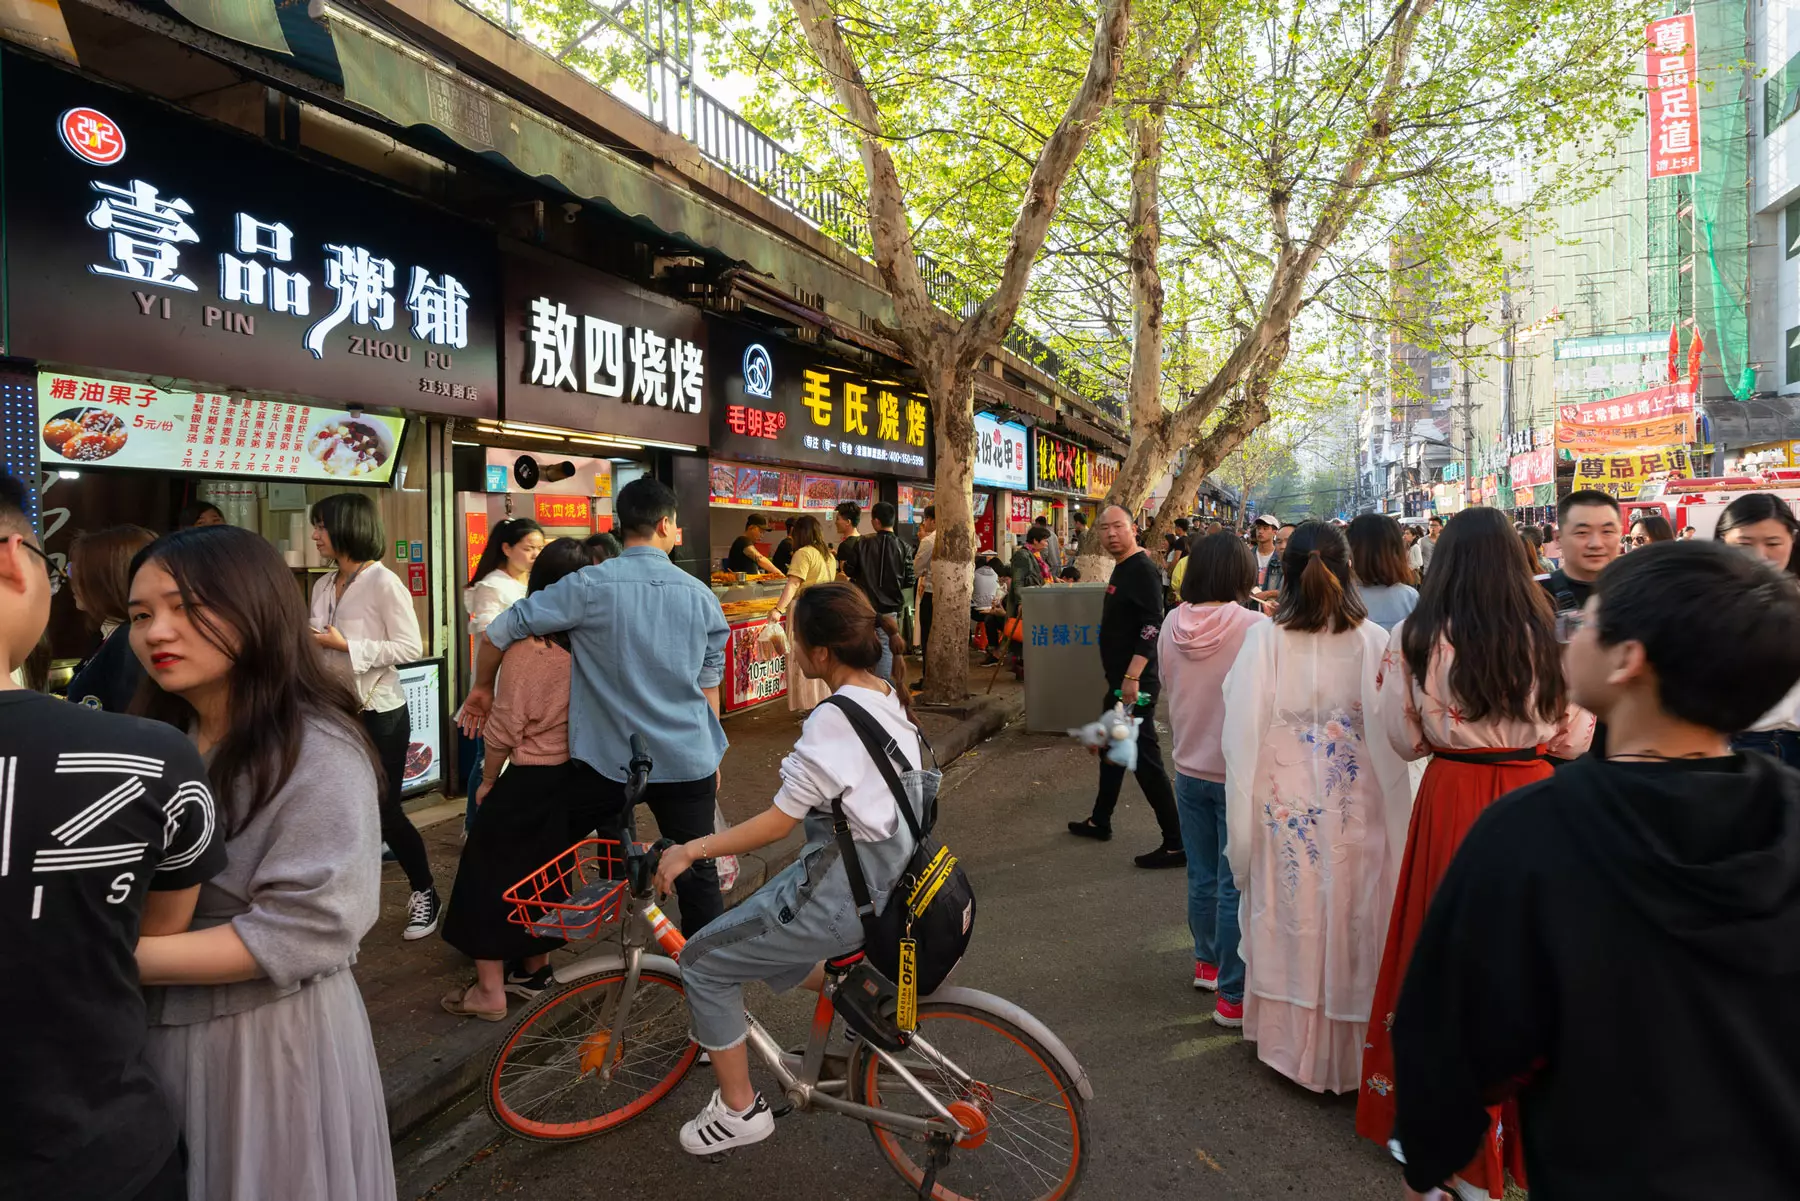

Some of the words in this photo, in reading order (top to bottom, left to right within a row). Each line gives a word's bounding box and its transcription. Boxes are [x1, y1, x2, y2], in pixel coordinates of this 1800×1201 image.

[1654, 22, 1692, 156] 尊品足道
[86, 179, 471, 359] 壹品粥铺
[135, 291, 170, 318] YI
[203, 306, 255, 336] PIN
[349, 335, 411, 363] ZHOU
[425, 350, 452, 370] PU
[529, 296, 704, 414] 敖四烧烤
[49, 377, 158, 409] 糖油果子
[419, 378, 478, 401] 江汉路店
[133, 414, 174, 433] 5元/份
[801, 368, 927, 448] 毛氏烧烤
[1581, 404, 1634, 424] 正常营业
[1579, 449, 1687, 479] 尊品足道
[539, 502, 588, 519] 敖四烧烤
[1031, 624, 1101, 648] 洁绿江
